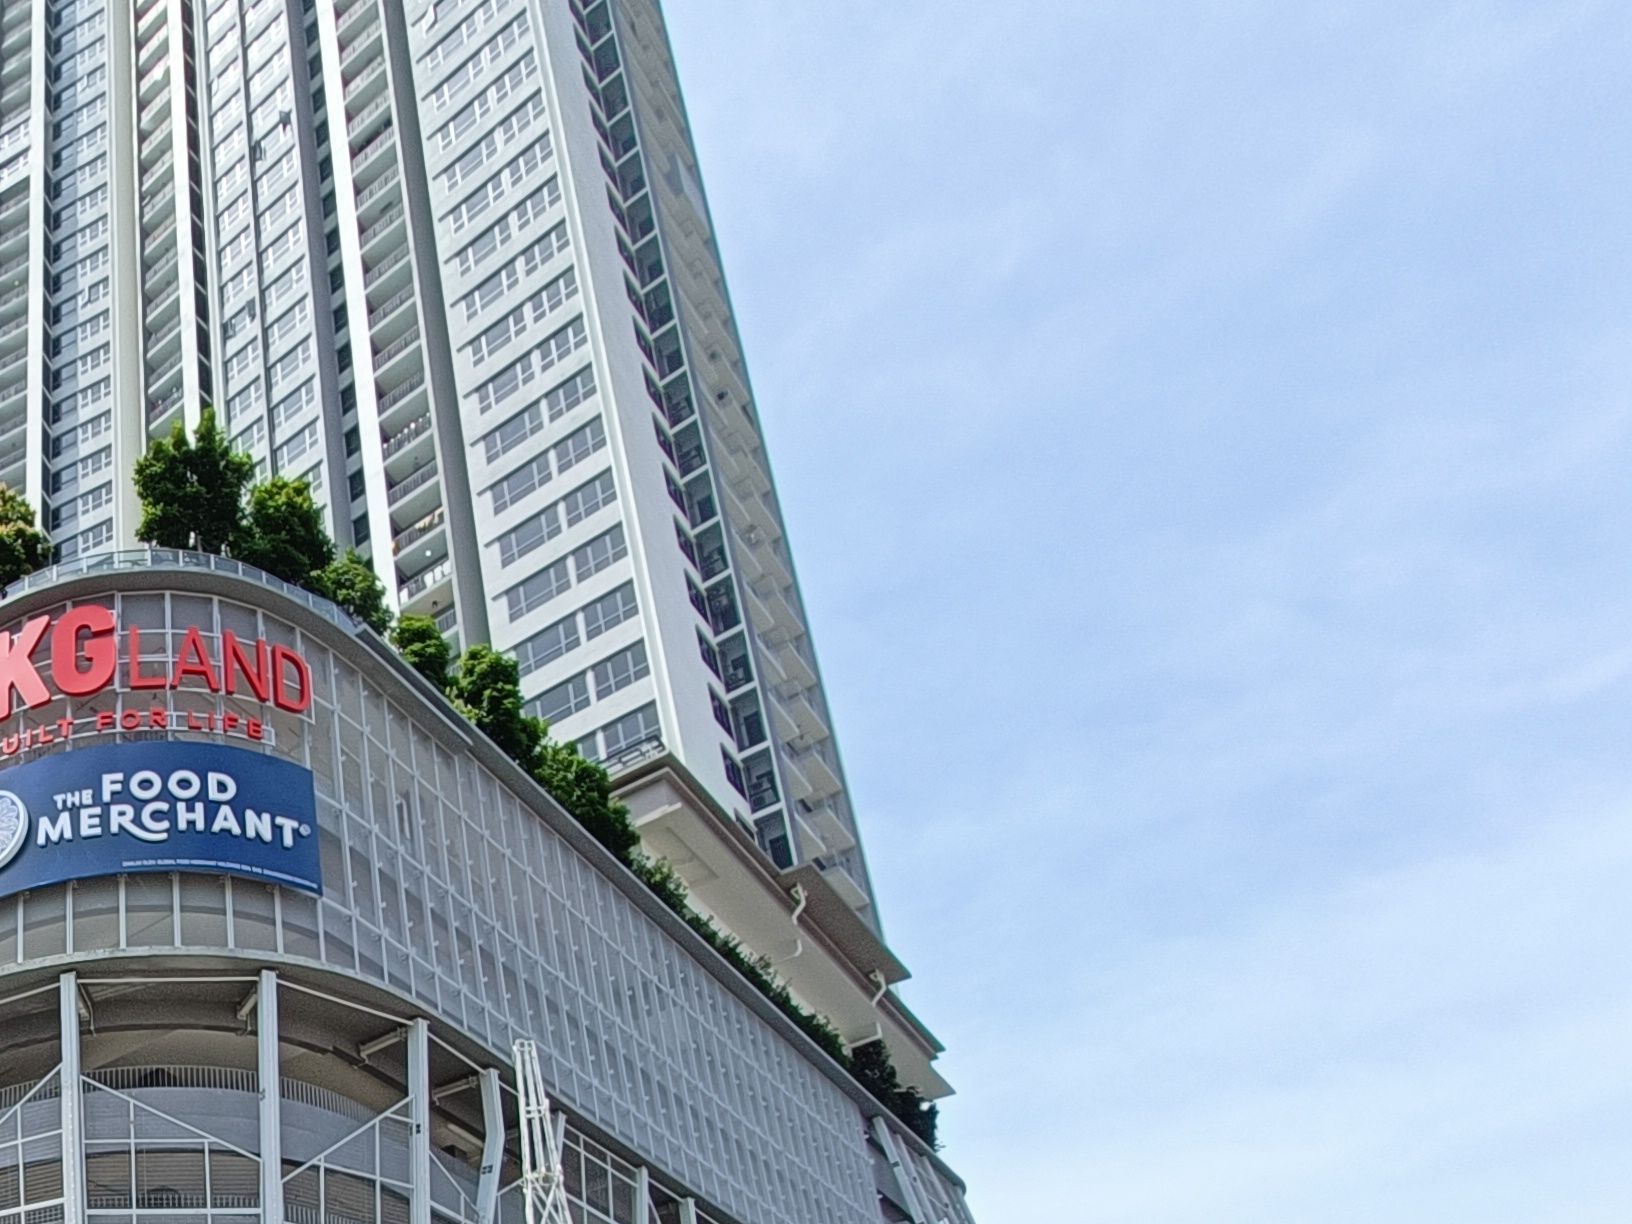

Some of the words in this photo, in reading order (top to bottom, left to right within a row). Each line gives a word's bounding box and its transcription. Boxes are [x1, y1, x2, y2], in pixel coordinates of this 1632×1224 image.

[95, 708, 168, 731] FOR
[187, 708, 265, 741] LIFE
[53, 787, 93, 811] THE
[100, 769, 238, 802] FOOD
